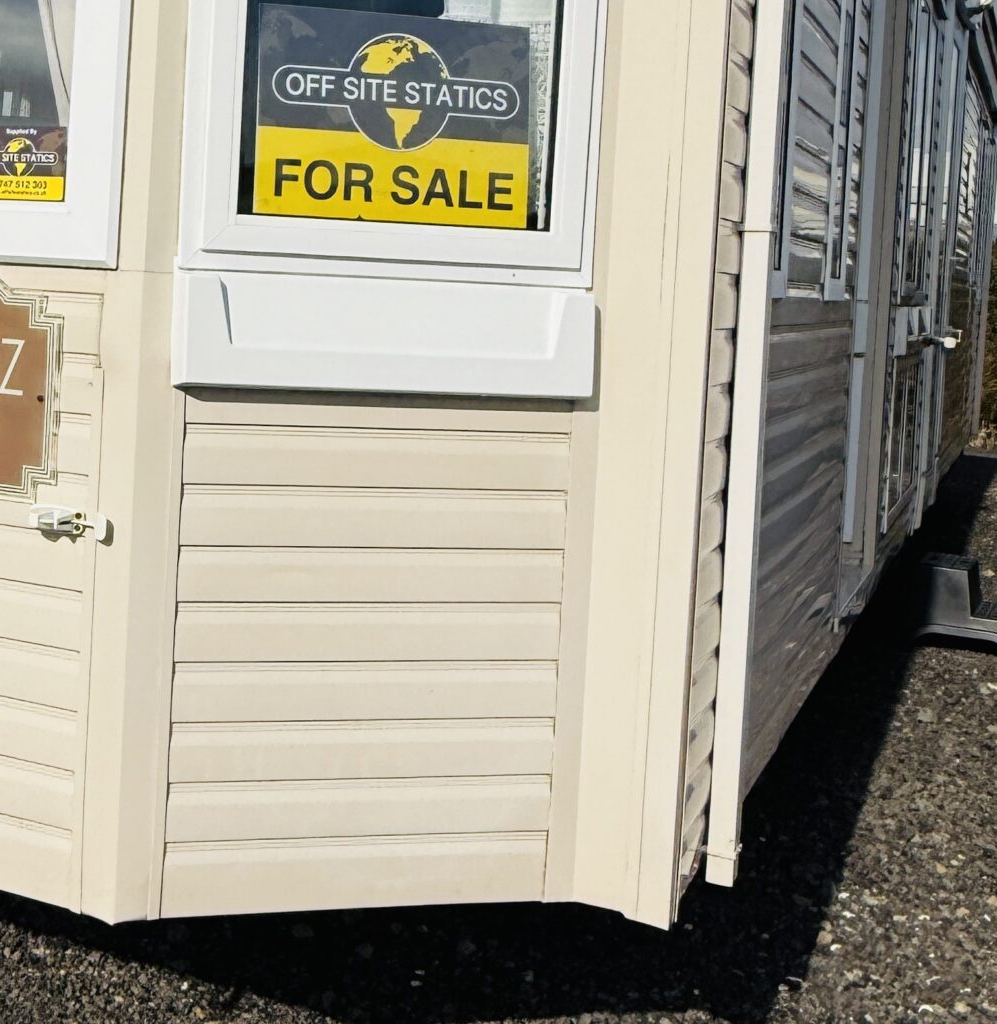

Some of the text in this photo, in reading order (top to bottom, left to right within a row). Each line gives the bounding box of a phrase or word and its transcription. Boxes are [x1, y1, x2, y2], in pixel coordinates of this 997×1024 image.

[285, 72, 508, 111] OFF SITE STATICS
[2, 153, 19, 162] SITE
[21, 154, 55, 162] STATICS
[273, 158, 514, 212] FOR SALE
